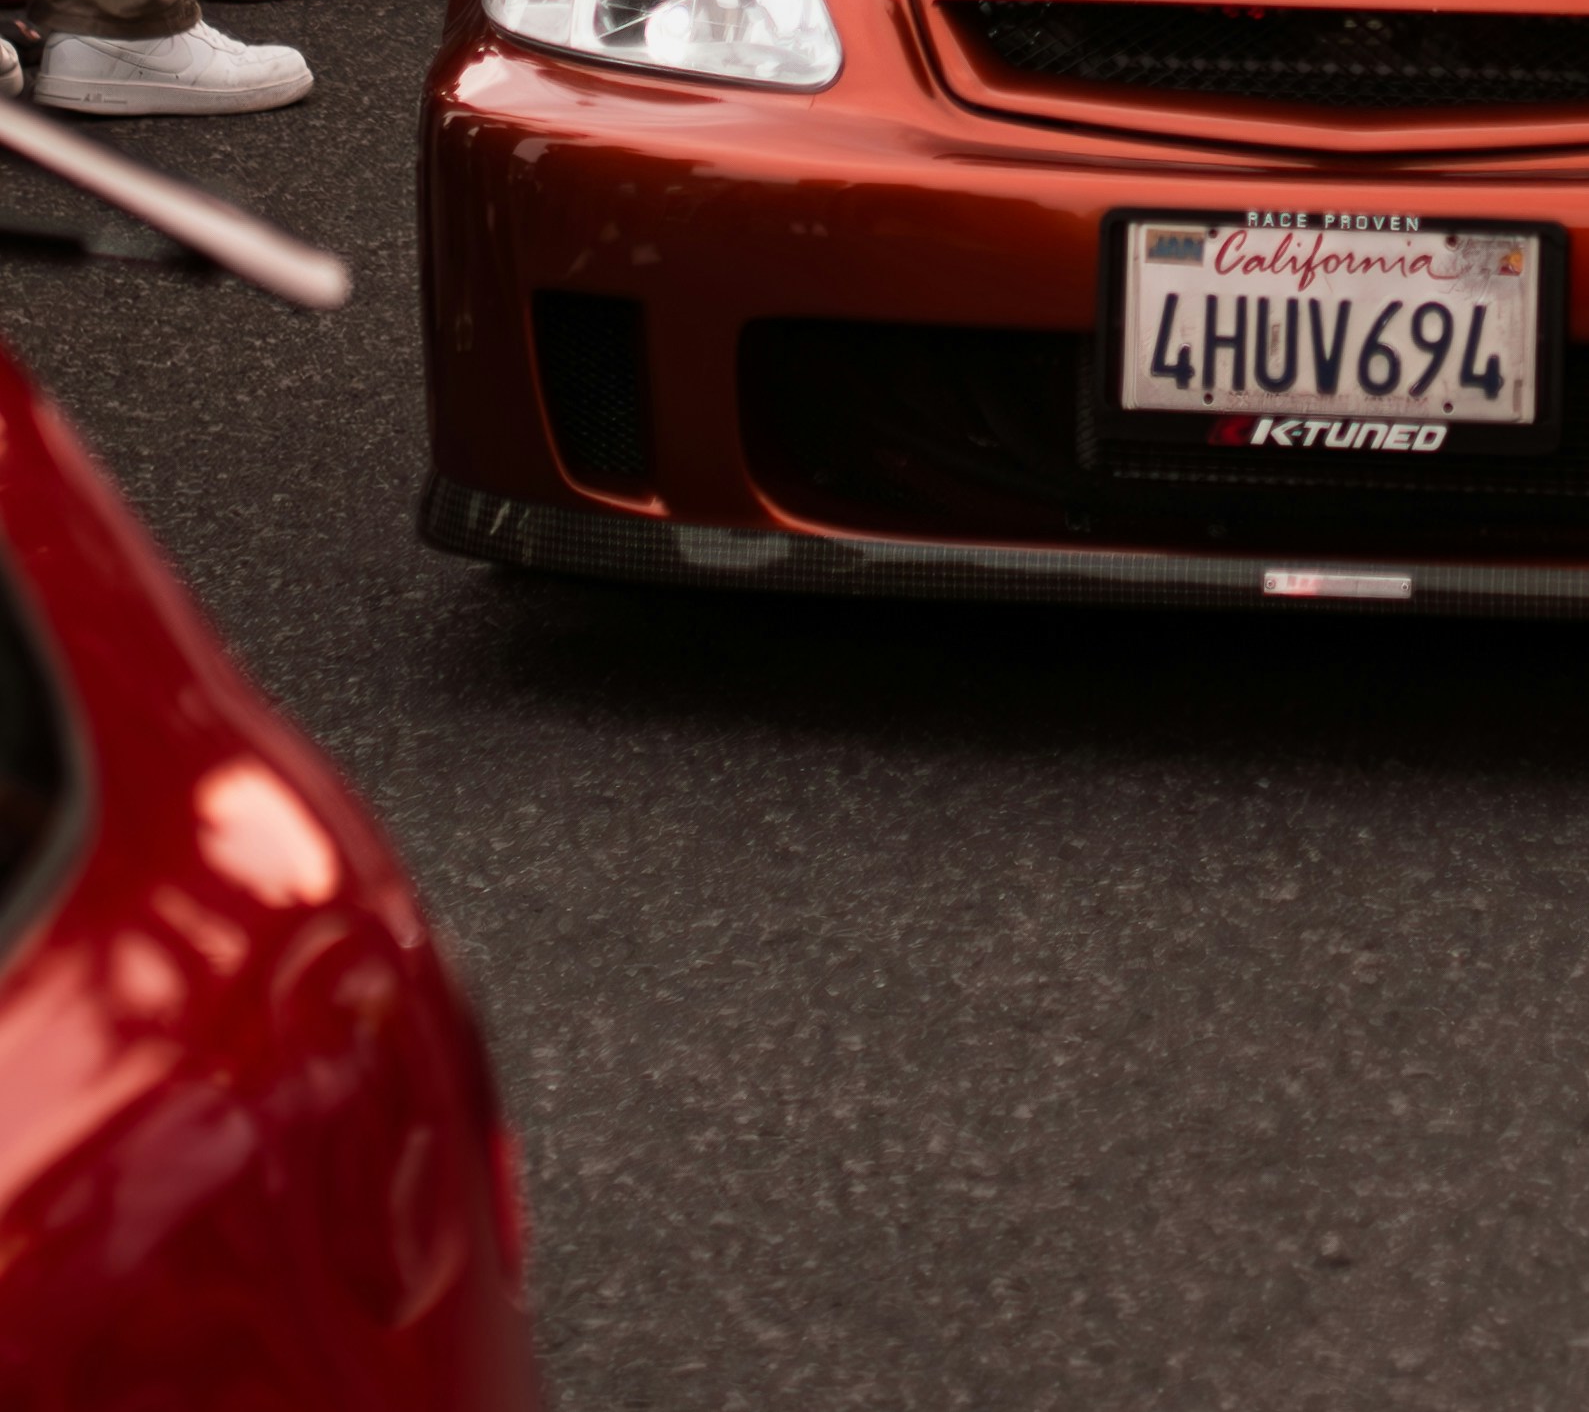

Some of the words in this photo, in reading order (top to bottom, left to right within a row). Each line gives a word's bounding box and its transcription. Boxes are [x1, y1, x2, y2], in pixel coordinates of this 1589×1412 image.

[1247, 211, 1308, 228] RACE
[1324, 213, 1420, 232] PROVEN
[1214, 229, 1462, 293] California
[1150, 292, 1504, 401] 4HUV694
[1250, 418, 1448, 452] K-TUNED
